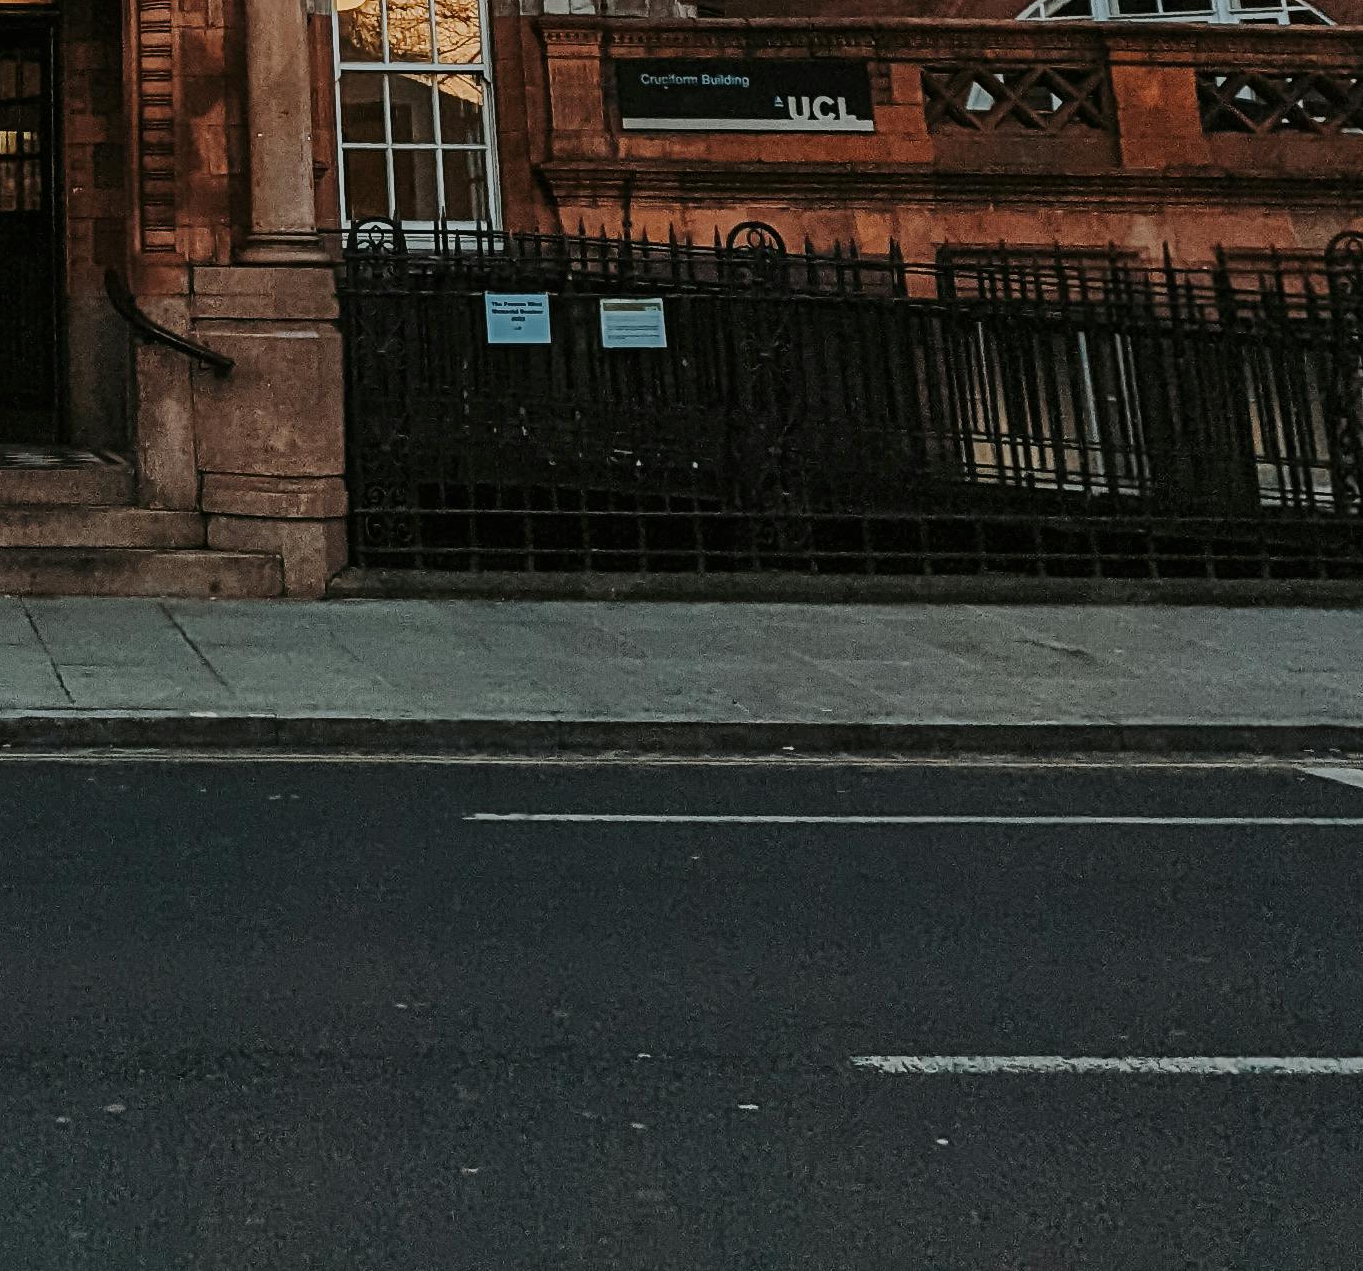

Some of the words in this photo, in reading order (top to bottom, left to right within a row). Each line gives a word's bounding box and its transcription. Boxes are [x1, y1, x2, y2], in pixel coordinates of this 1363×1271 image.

[640, 73, 698, 86] Cruciform
[701, 74, 750, 88] Building
[788, 95, 858, 120] UCL
